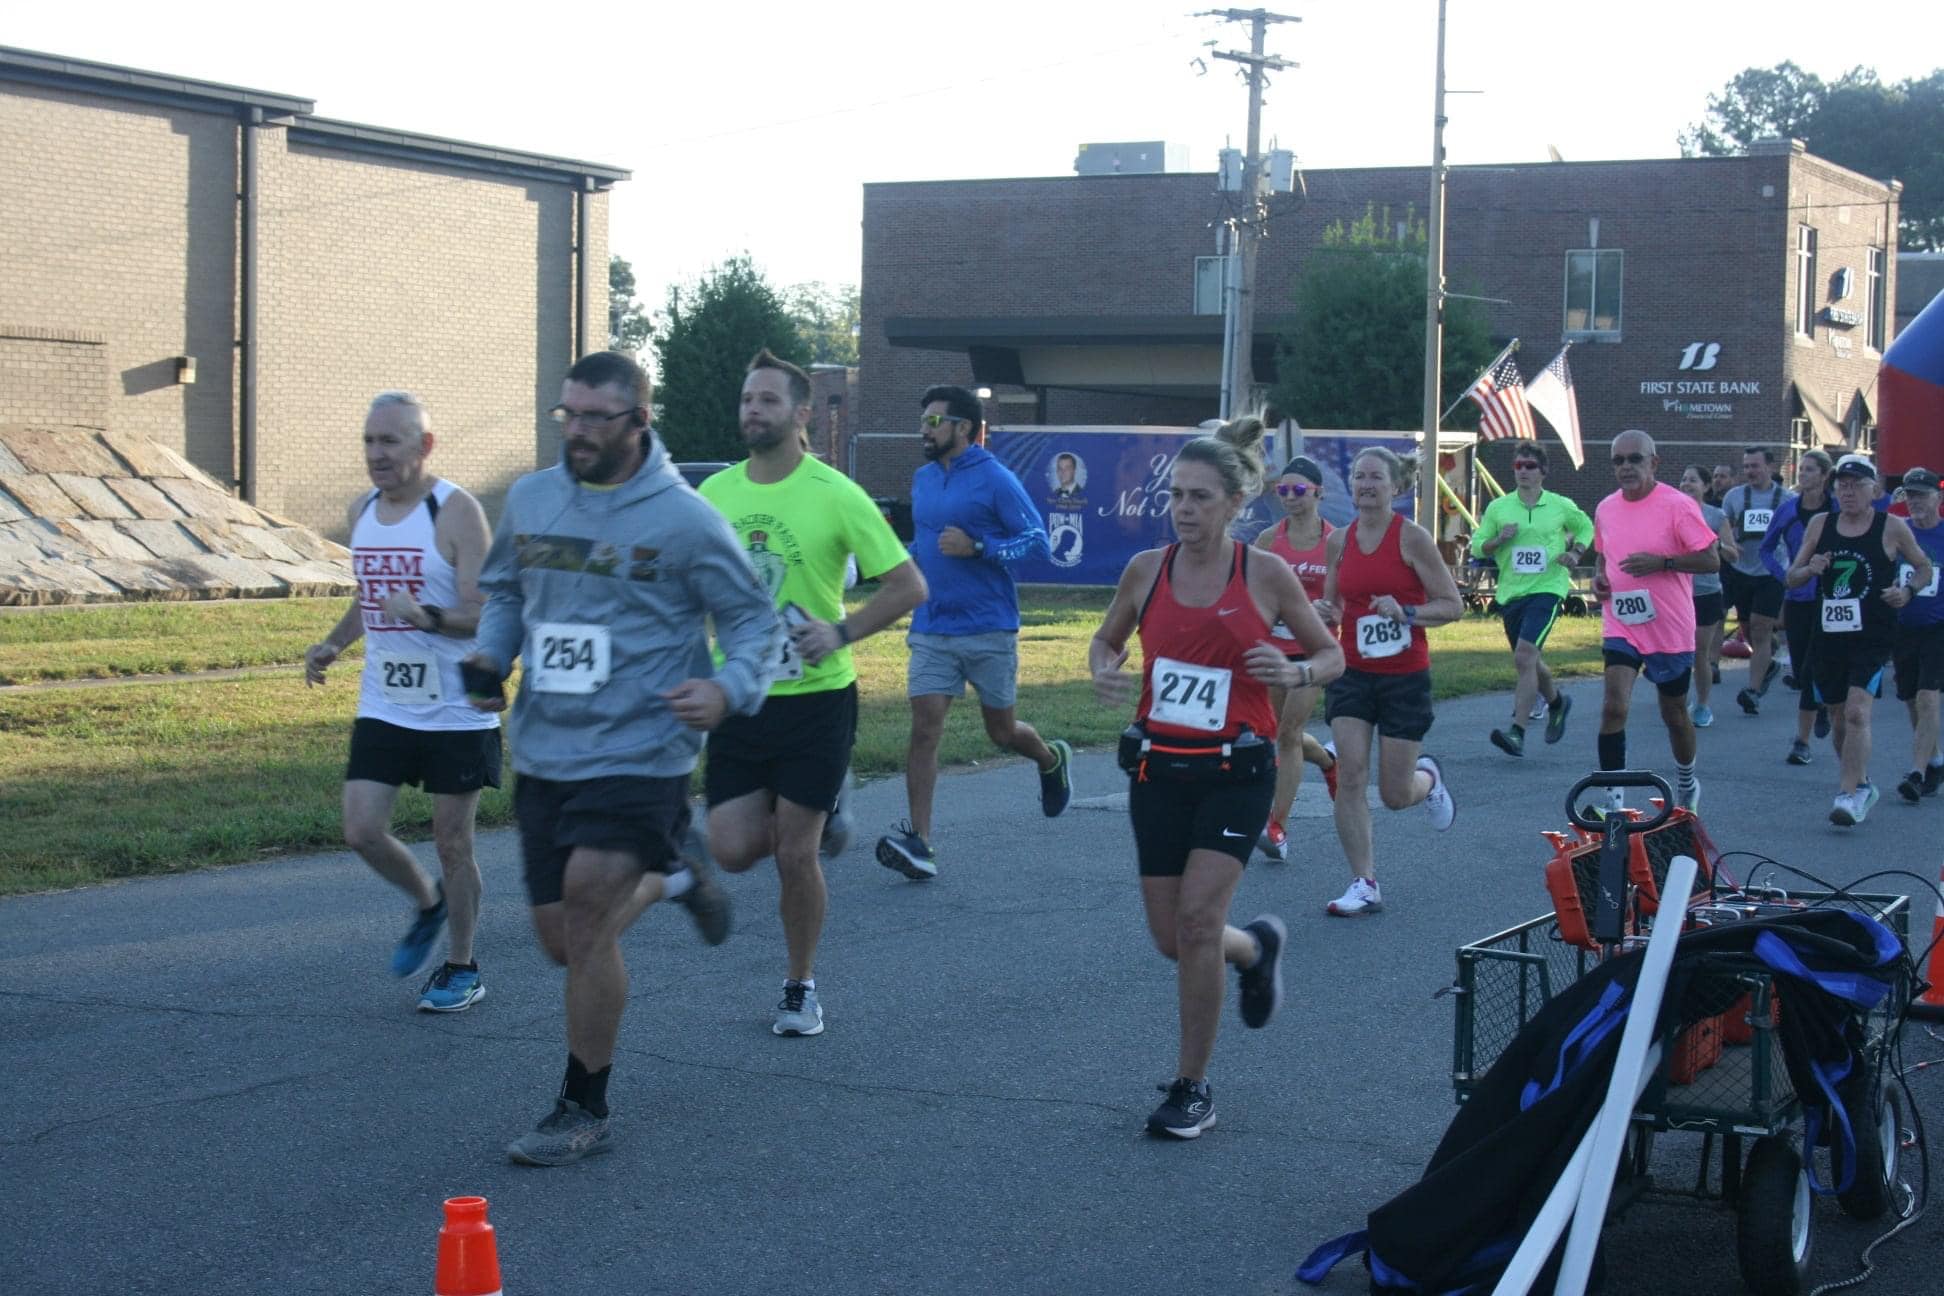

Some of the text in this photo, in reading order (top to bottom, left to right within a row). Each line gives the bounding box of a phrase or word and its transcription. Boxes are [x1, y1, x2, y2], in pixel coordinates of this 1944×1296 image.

[1640, 382, 1760, 394] FIRST STATE BANK
[1098, 487, 1149, 518] Not
[1749, 512, 1770, 525] 245
[354, 555, 424, 576] TEAM
[1516, 551, 1542, 566] 262
[1309, 564, 1328, 575] FEE
[1832, 560, 1858, 589] 7
[1615, 596, 1647, 616] 280
[1825, 605, 1854, 622] 285
[1363, 620, 1402, 646] 263
[543, 637, 595, 671] 254
[384, 661, 427, 688] 237
[1160, 672, 1217, 710] 274
